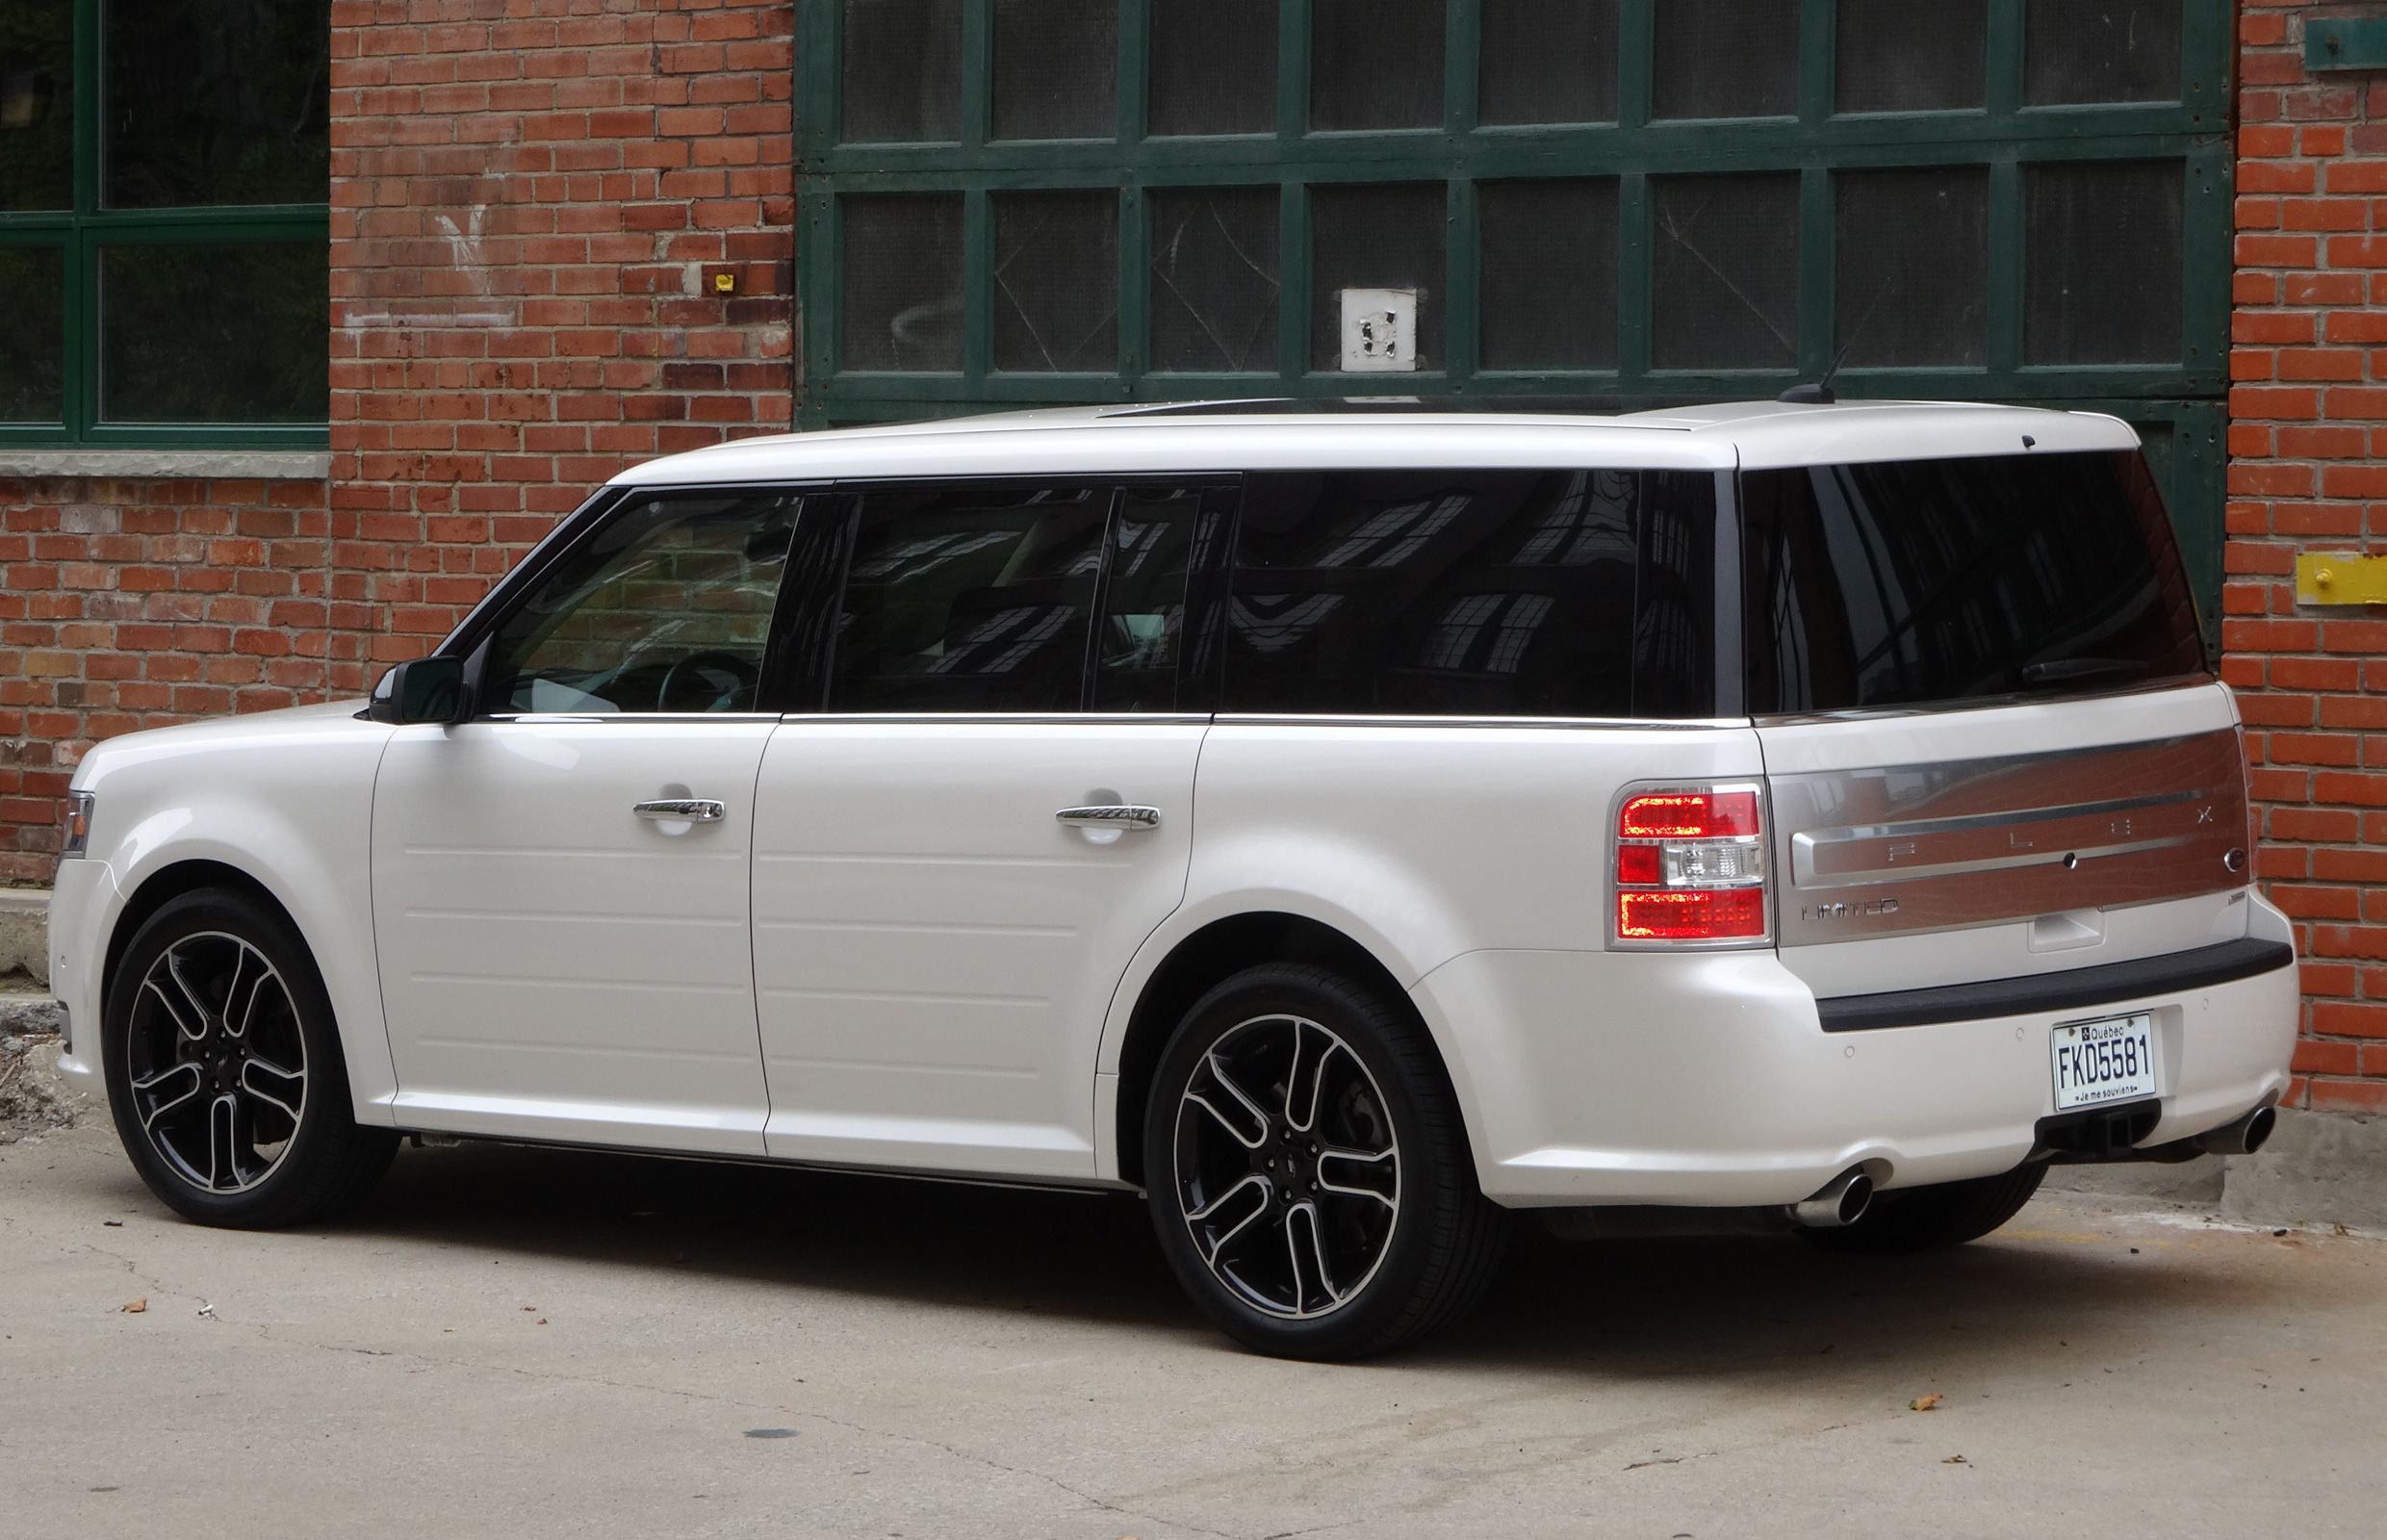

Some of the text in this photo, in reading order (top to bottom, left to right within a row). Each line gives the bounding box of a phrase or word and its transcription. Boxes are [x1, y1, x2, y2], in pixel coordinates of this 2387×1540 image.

[2091, 1026, 2124, 1040] Québec
[2058, 1034, 2149, 1090] FKD5581
[2090, 1090, 2101, 1100] me
